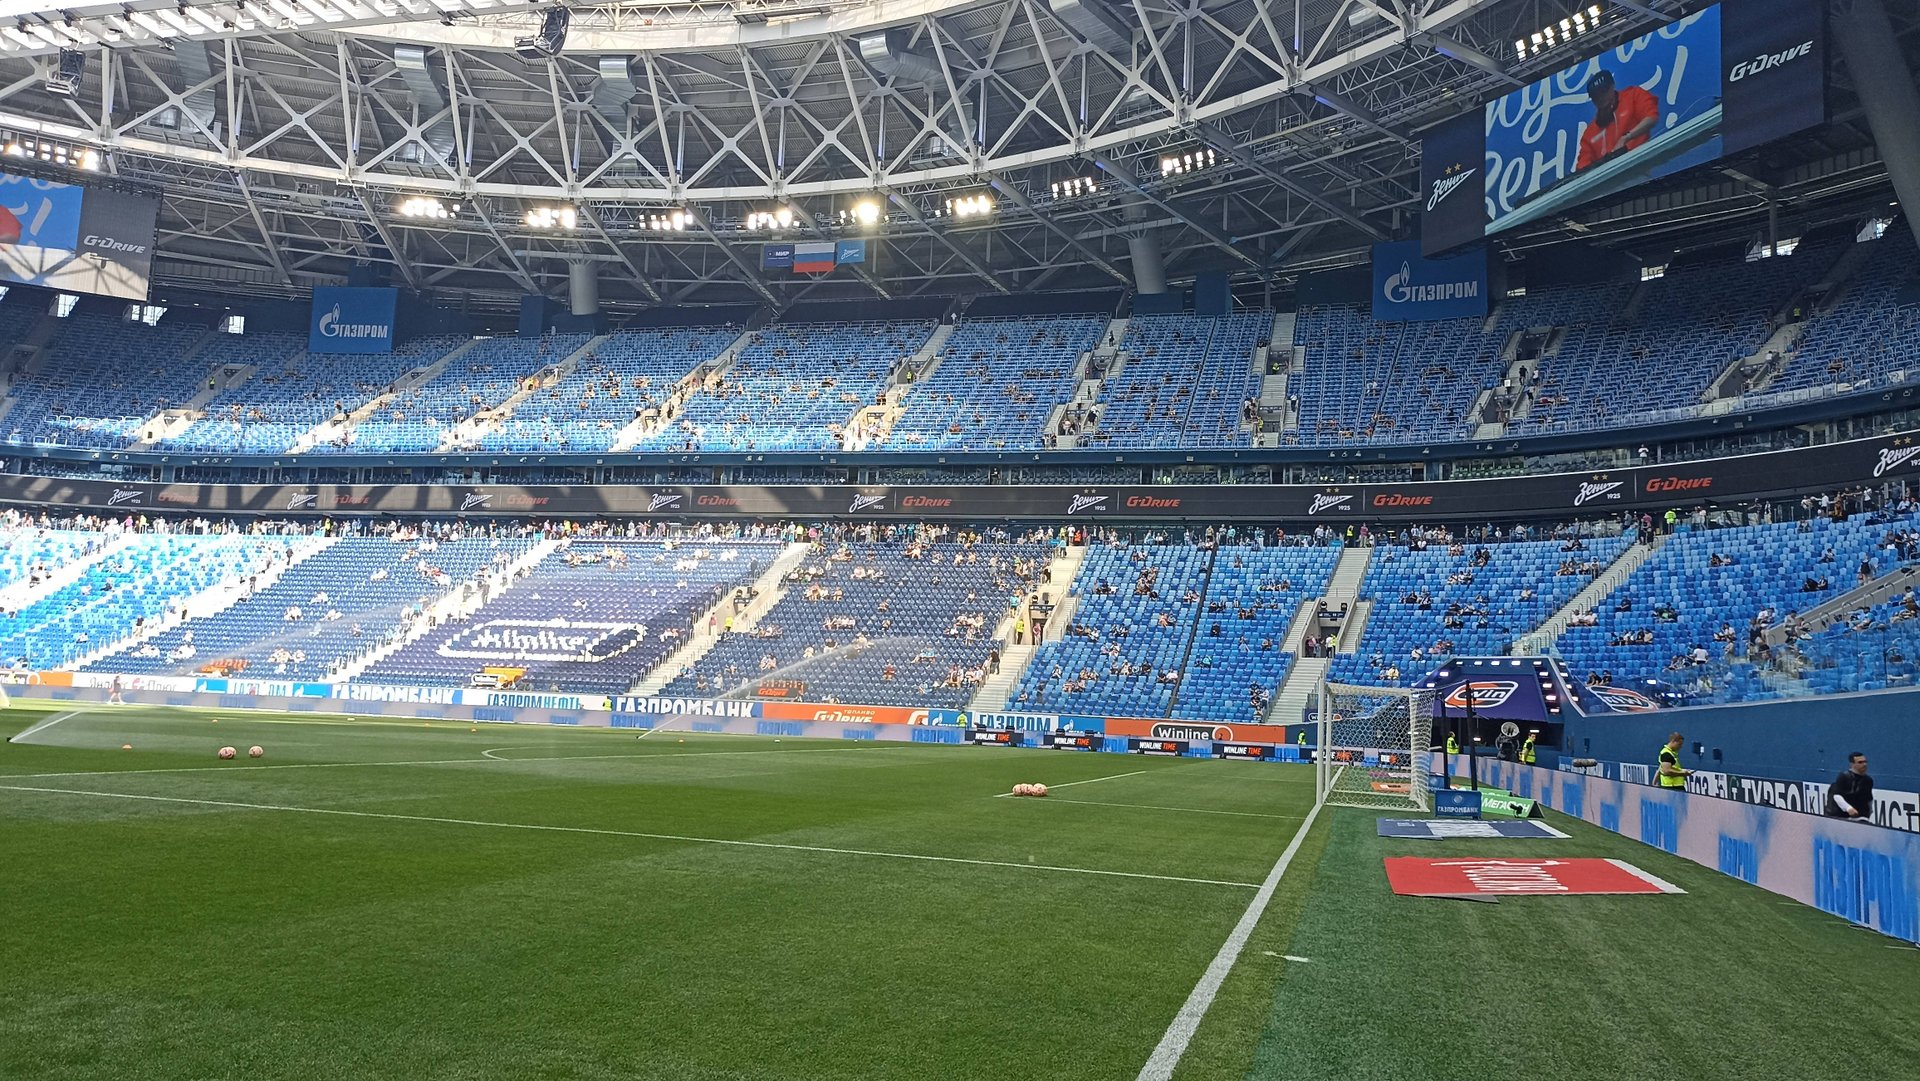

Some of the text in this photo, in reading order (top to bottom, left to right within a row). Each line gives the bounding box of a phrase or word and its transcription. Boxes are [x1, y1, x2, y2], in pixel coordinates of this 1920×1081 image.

[1411, 281, 1477, 302] ГАЗПРОМ
[339, 324, 388, 338] ГАЗПРОМ
[616, 697, 754, 717] ГАЗПРОМБАНК
[1158, 727, 1209, 740] Winline
